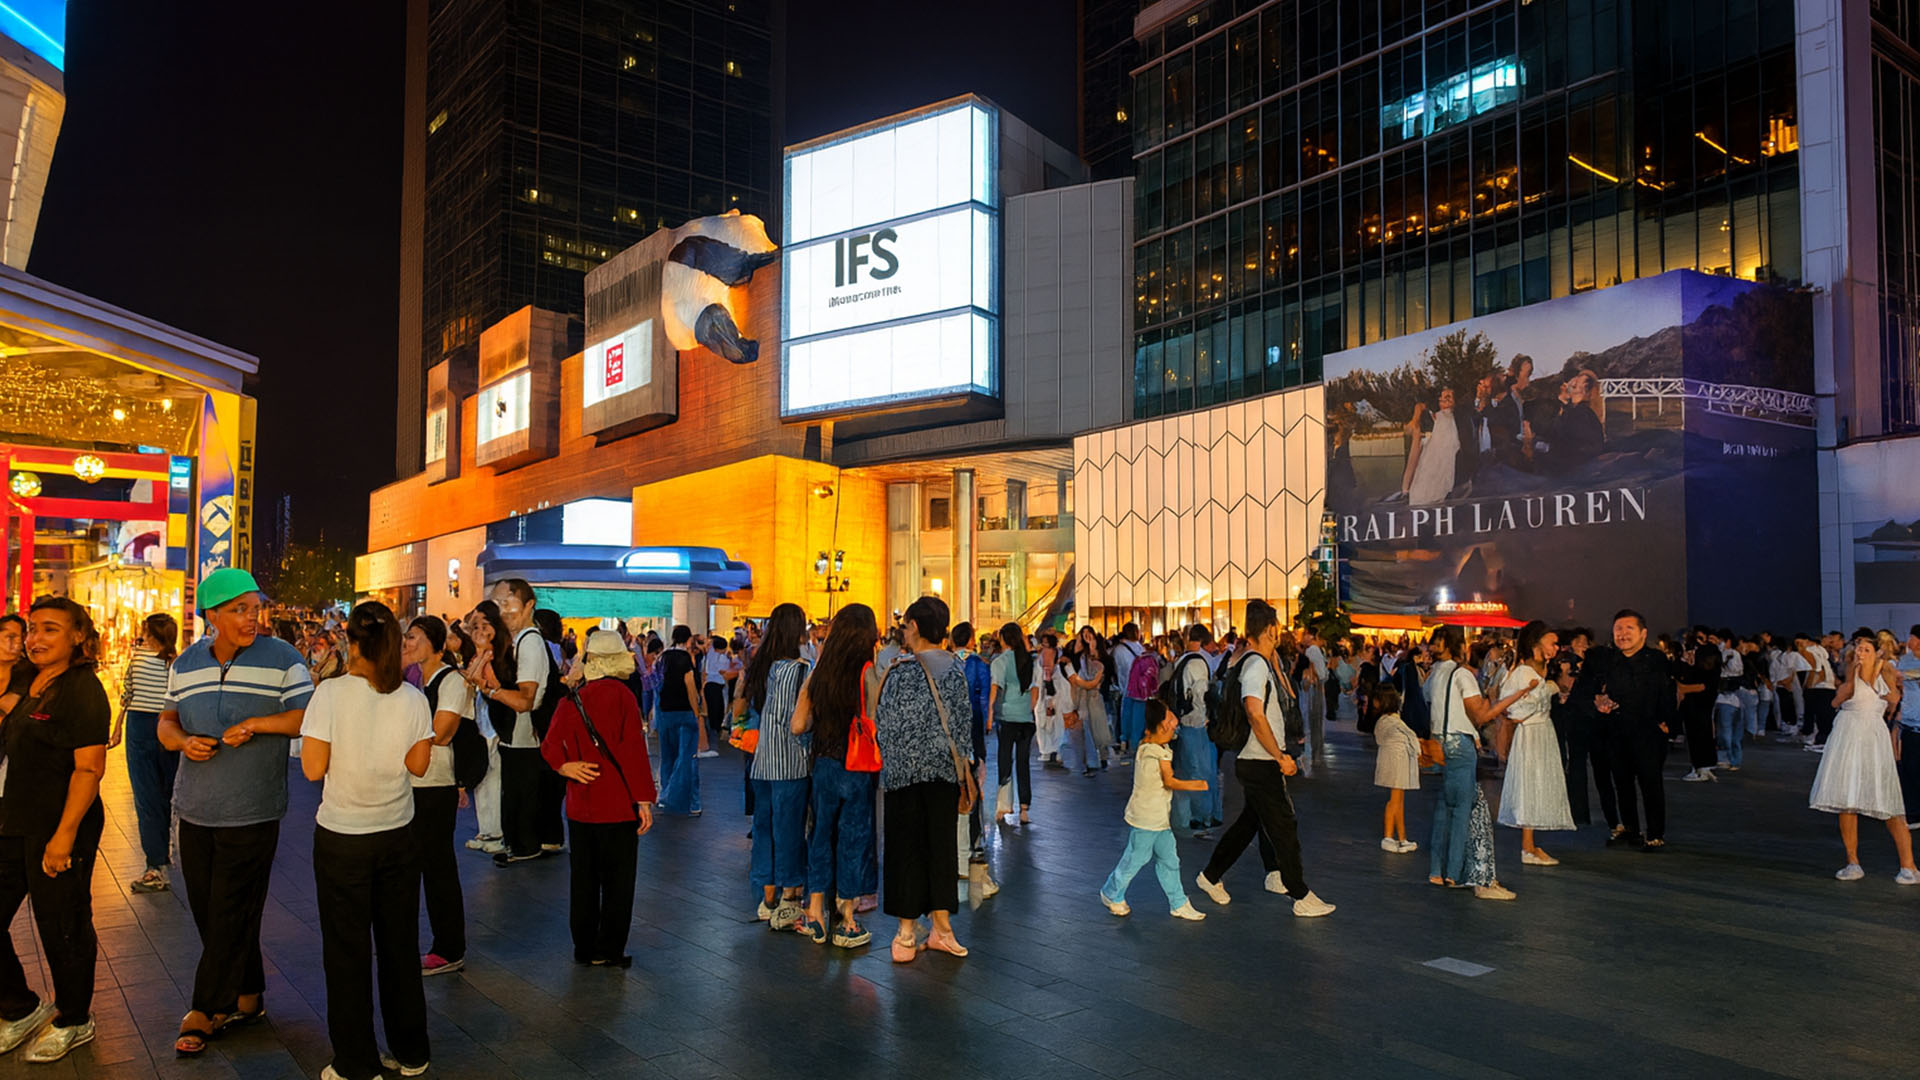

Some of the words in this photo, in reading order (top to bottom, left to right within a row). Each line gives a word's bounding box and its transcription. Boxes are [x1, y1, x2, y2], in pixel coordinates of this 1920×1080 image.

[835, 227, 899, 288] IFS
[1342, 505, 1456, 543] RALPH
[1472, 487, 1648, 534] LAUREN
